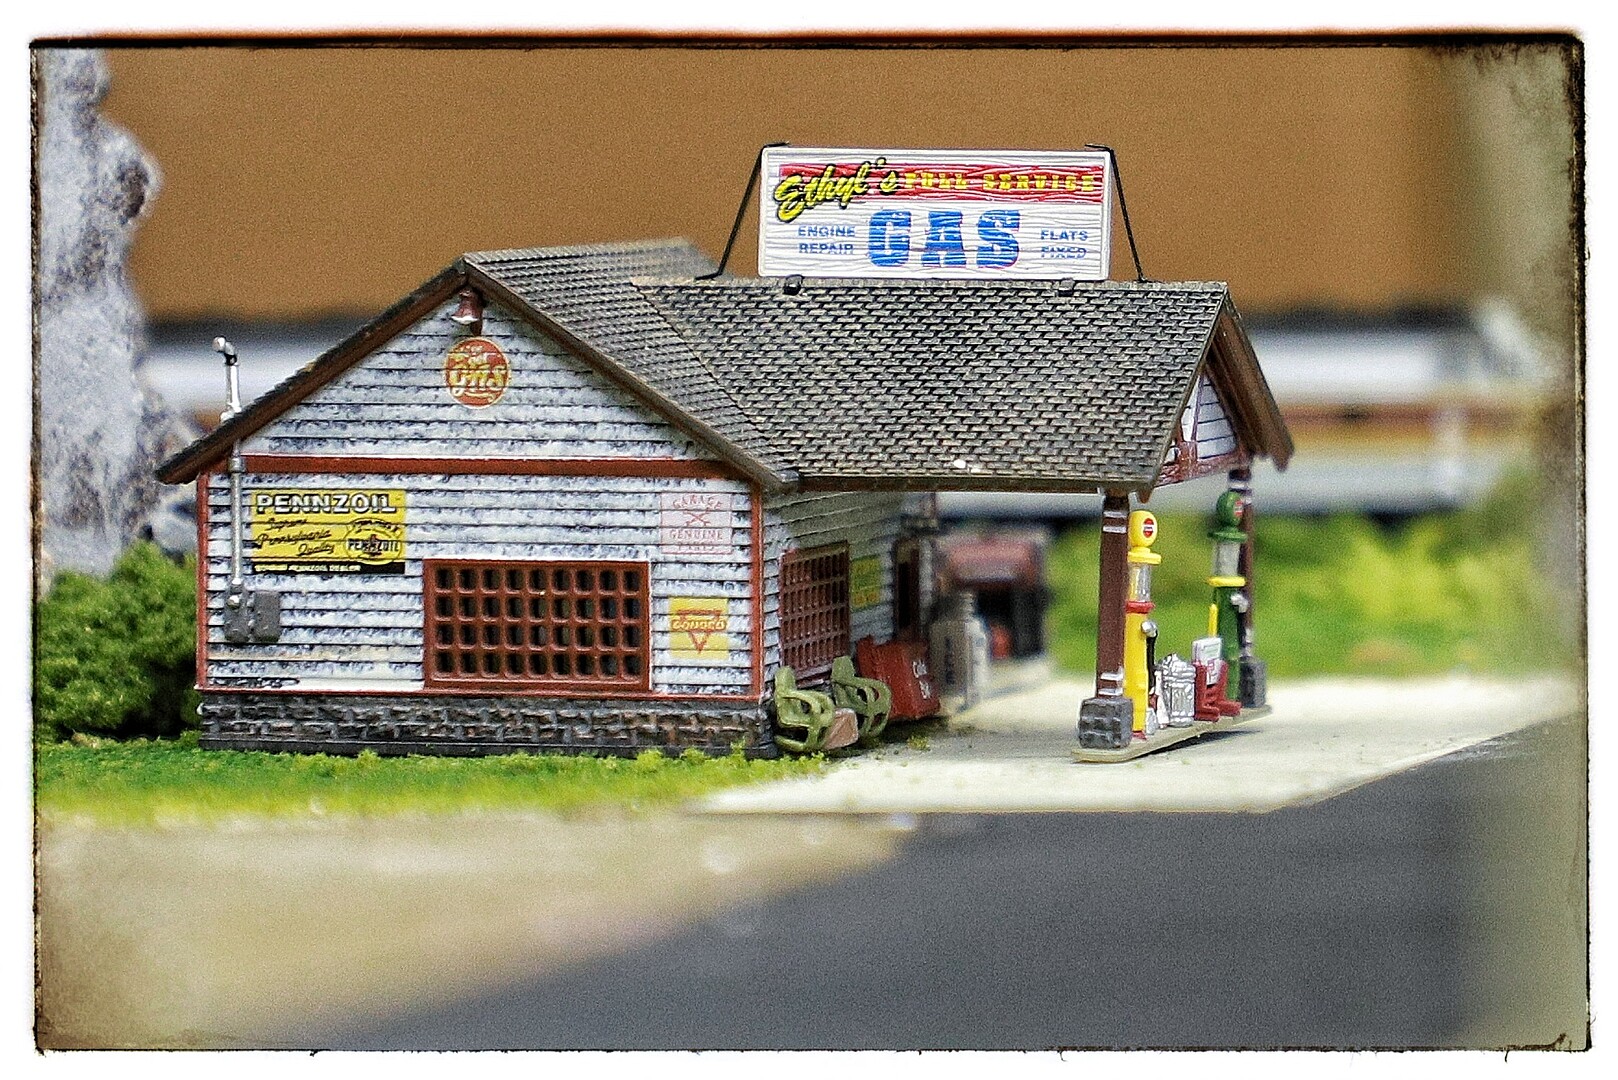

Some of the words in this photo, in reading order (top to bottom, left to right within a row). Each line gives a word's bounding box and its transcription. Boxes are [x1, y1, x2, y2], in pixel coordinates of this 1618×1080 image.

[773, 157, 898, 223] Ethyl's
[904, 172, 967, 190] FULL
[983, 173, 1095, 192] SERVICE
[798, 225, 856, 237] ENGINE
[1041, 229, 1088, 241] FLATS
[867, 209, 1020, 268] GAS
[799, 242, 854, 255] REPAIR
[1041, 246, 1087, 259] FIXED
[255, 493, 397, 514] PENNZOIL
[669, 528, 723, 540] GENUINE
[672, 620, 726, 630] CONOCO
